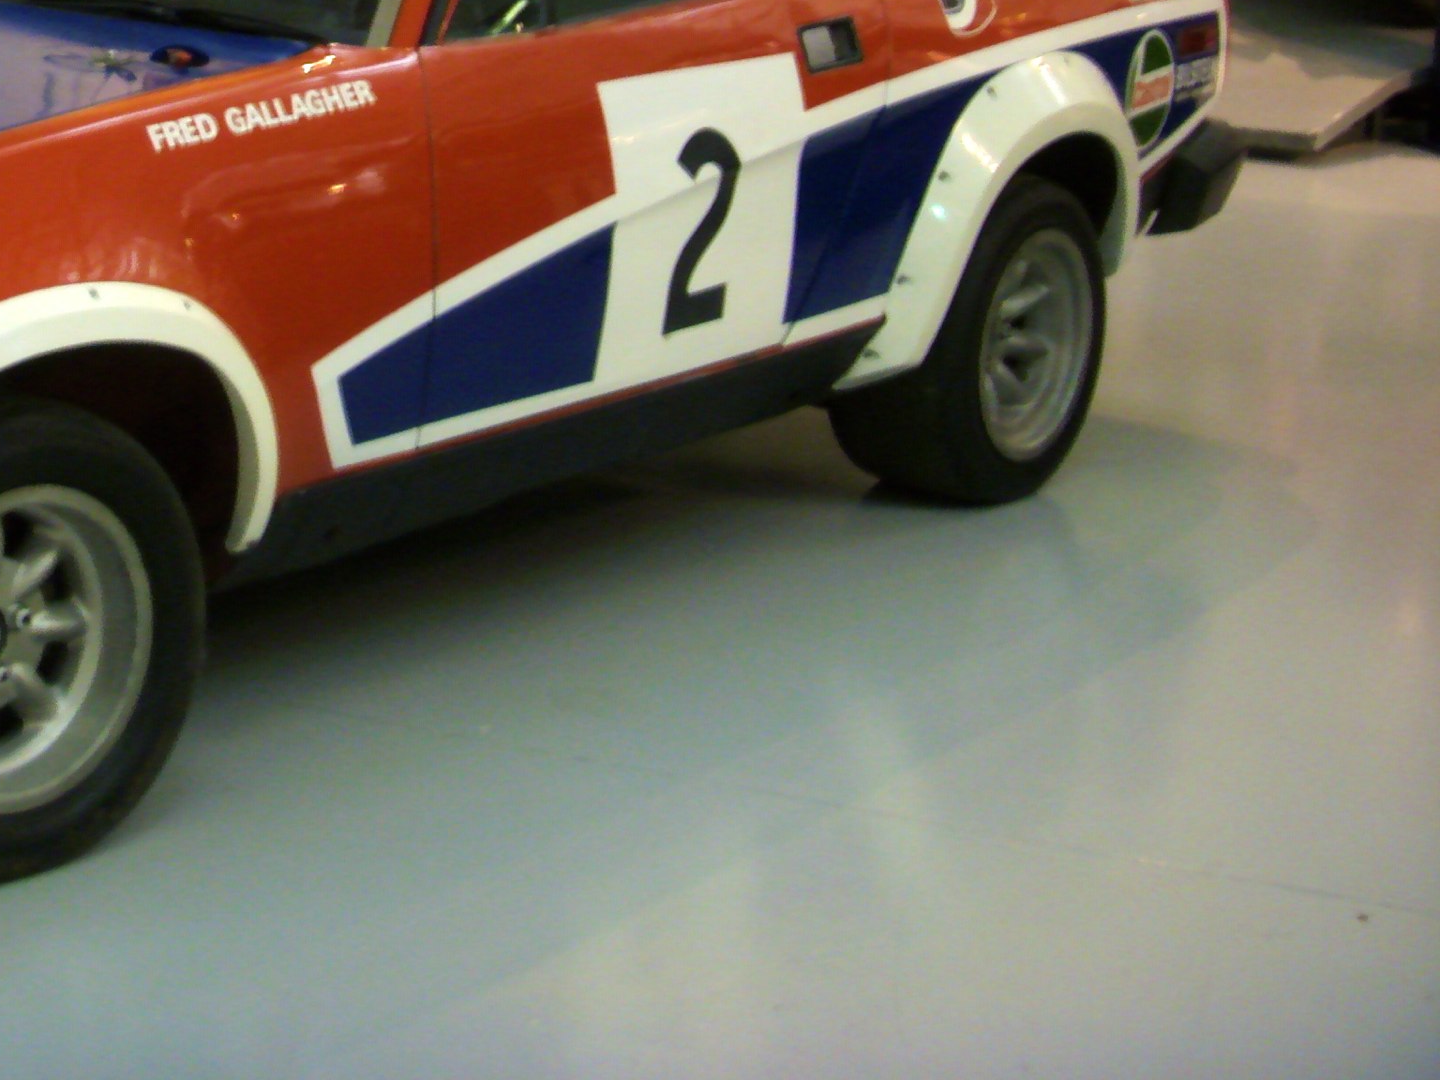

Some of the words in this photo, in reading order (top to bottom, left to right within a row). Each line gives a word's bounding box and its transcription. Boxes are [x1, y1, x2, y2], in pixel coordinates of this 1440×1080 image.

[146, 113, 220, 152] FRED
[224, 80, 377, 135] GALLAGHER
[662, 127, 743, 337] 2
